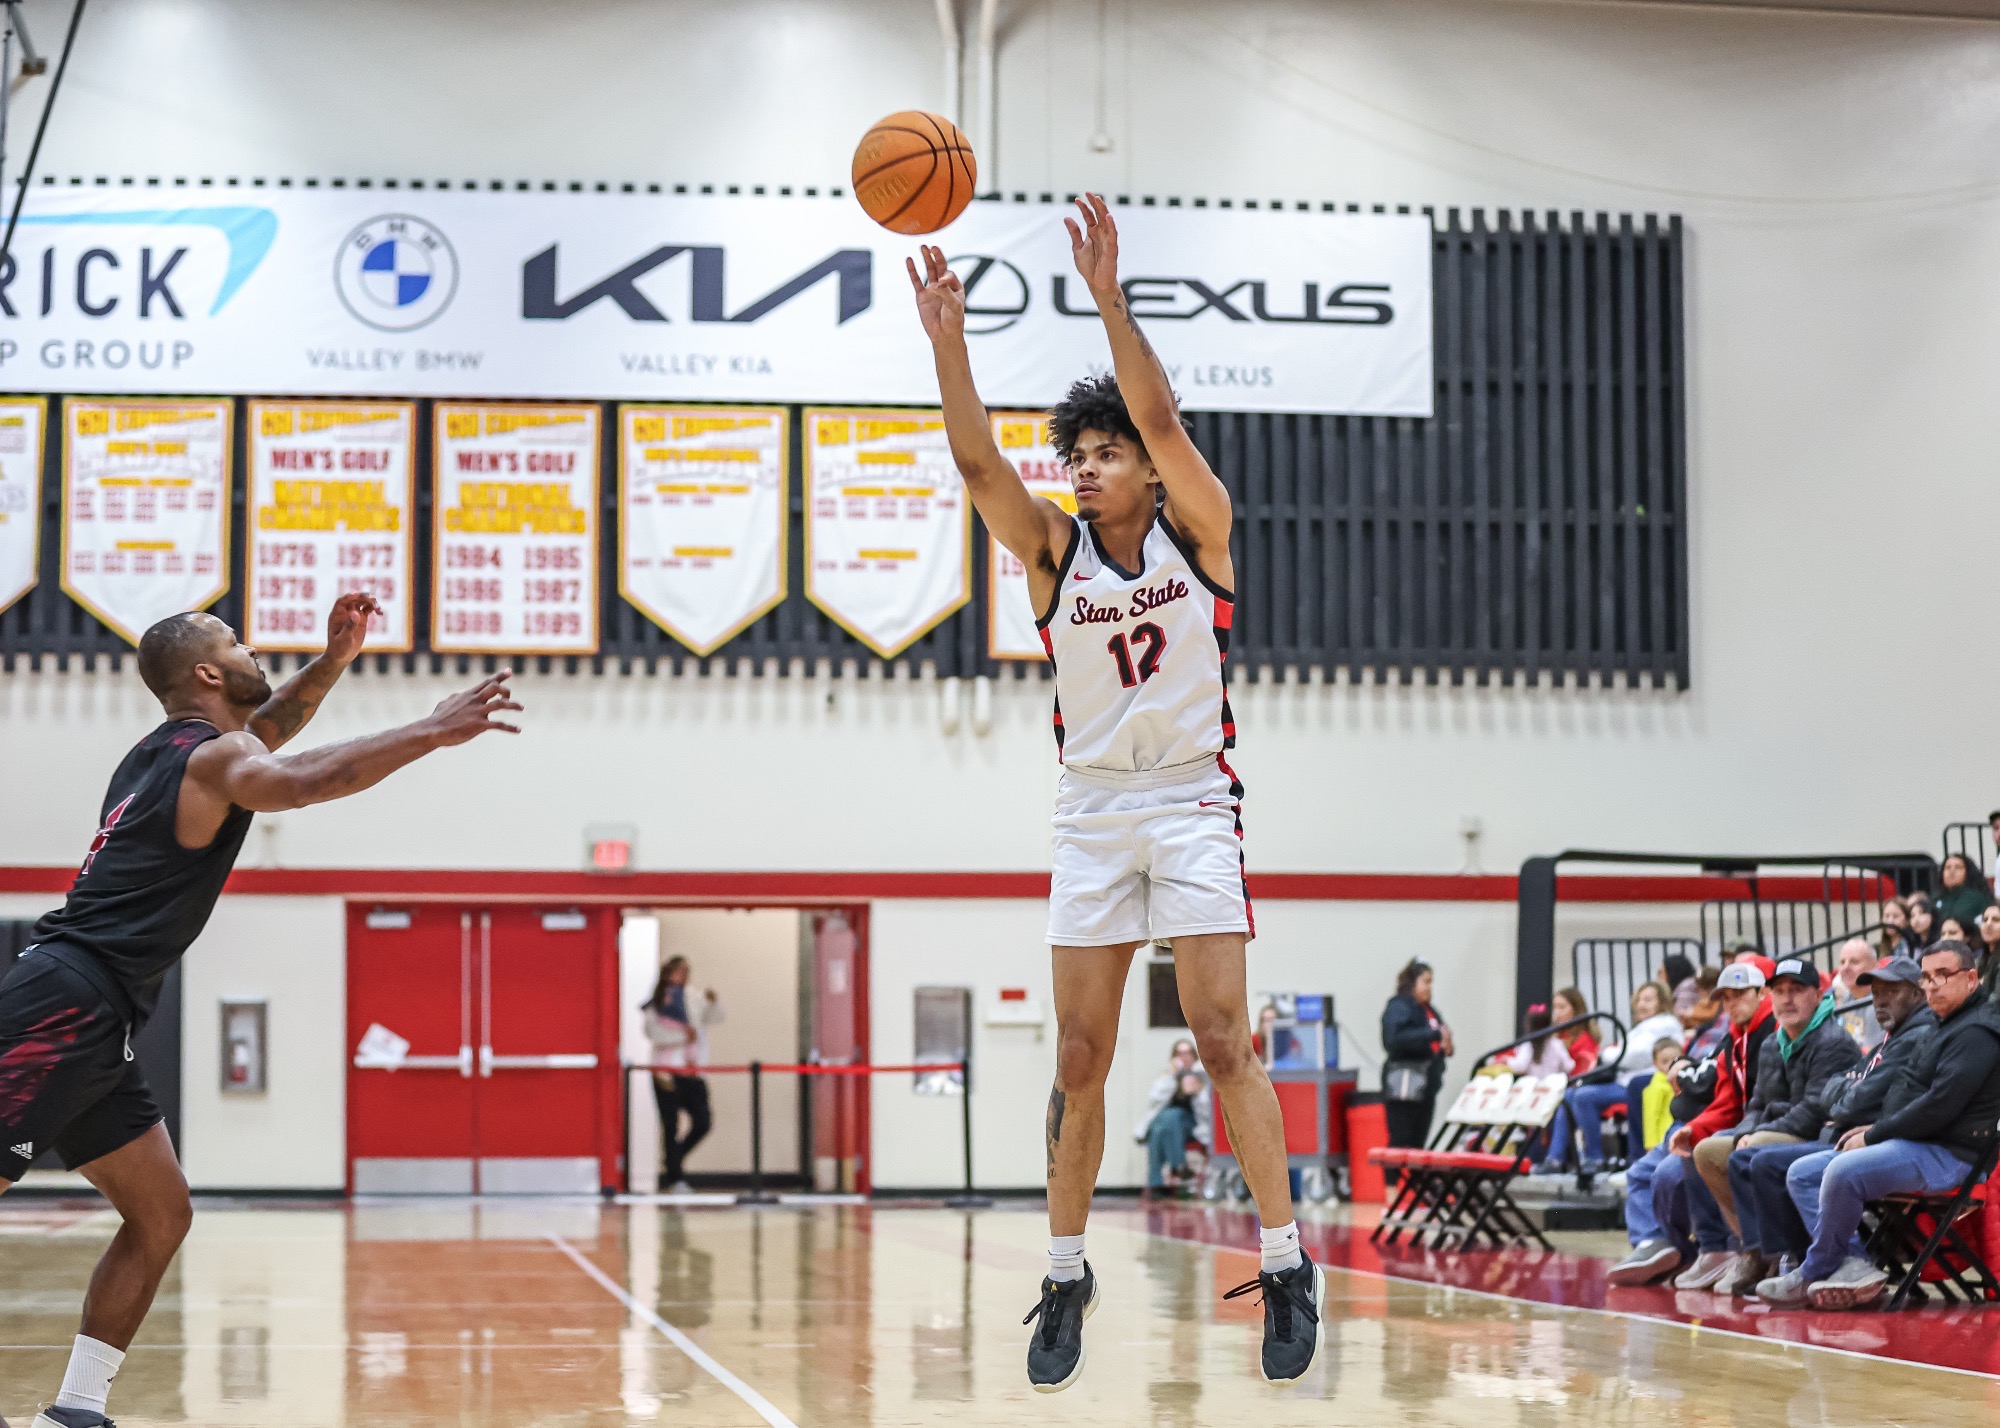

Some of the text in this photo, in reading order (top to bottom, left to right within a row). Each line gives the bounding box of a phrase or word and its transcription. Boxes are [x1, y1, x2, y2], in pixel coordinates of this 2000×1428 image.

[523, 243, 872, 326] KIA
[1052, 274, 1394, 325] LEXUS
[40, 340, 194, 369] GROUP
[306, 347, 485, 371] VALLEY BMW
[621, 354, 773, 375] VALLEY KIA
[1193, 364, 1273, 386] LEXUS
[271, 449, 391, 471] MEN'S GOLF
[456, 452, 576, 474] MEN'S GOLF
[1070, 578, 1189, 625] Stan State
[1106, 621, 1167, 688] 12
